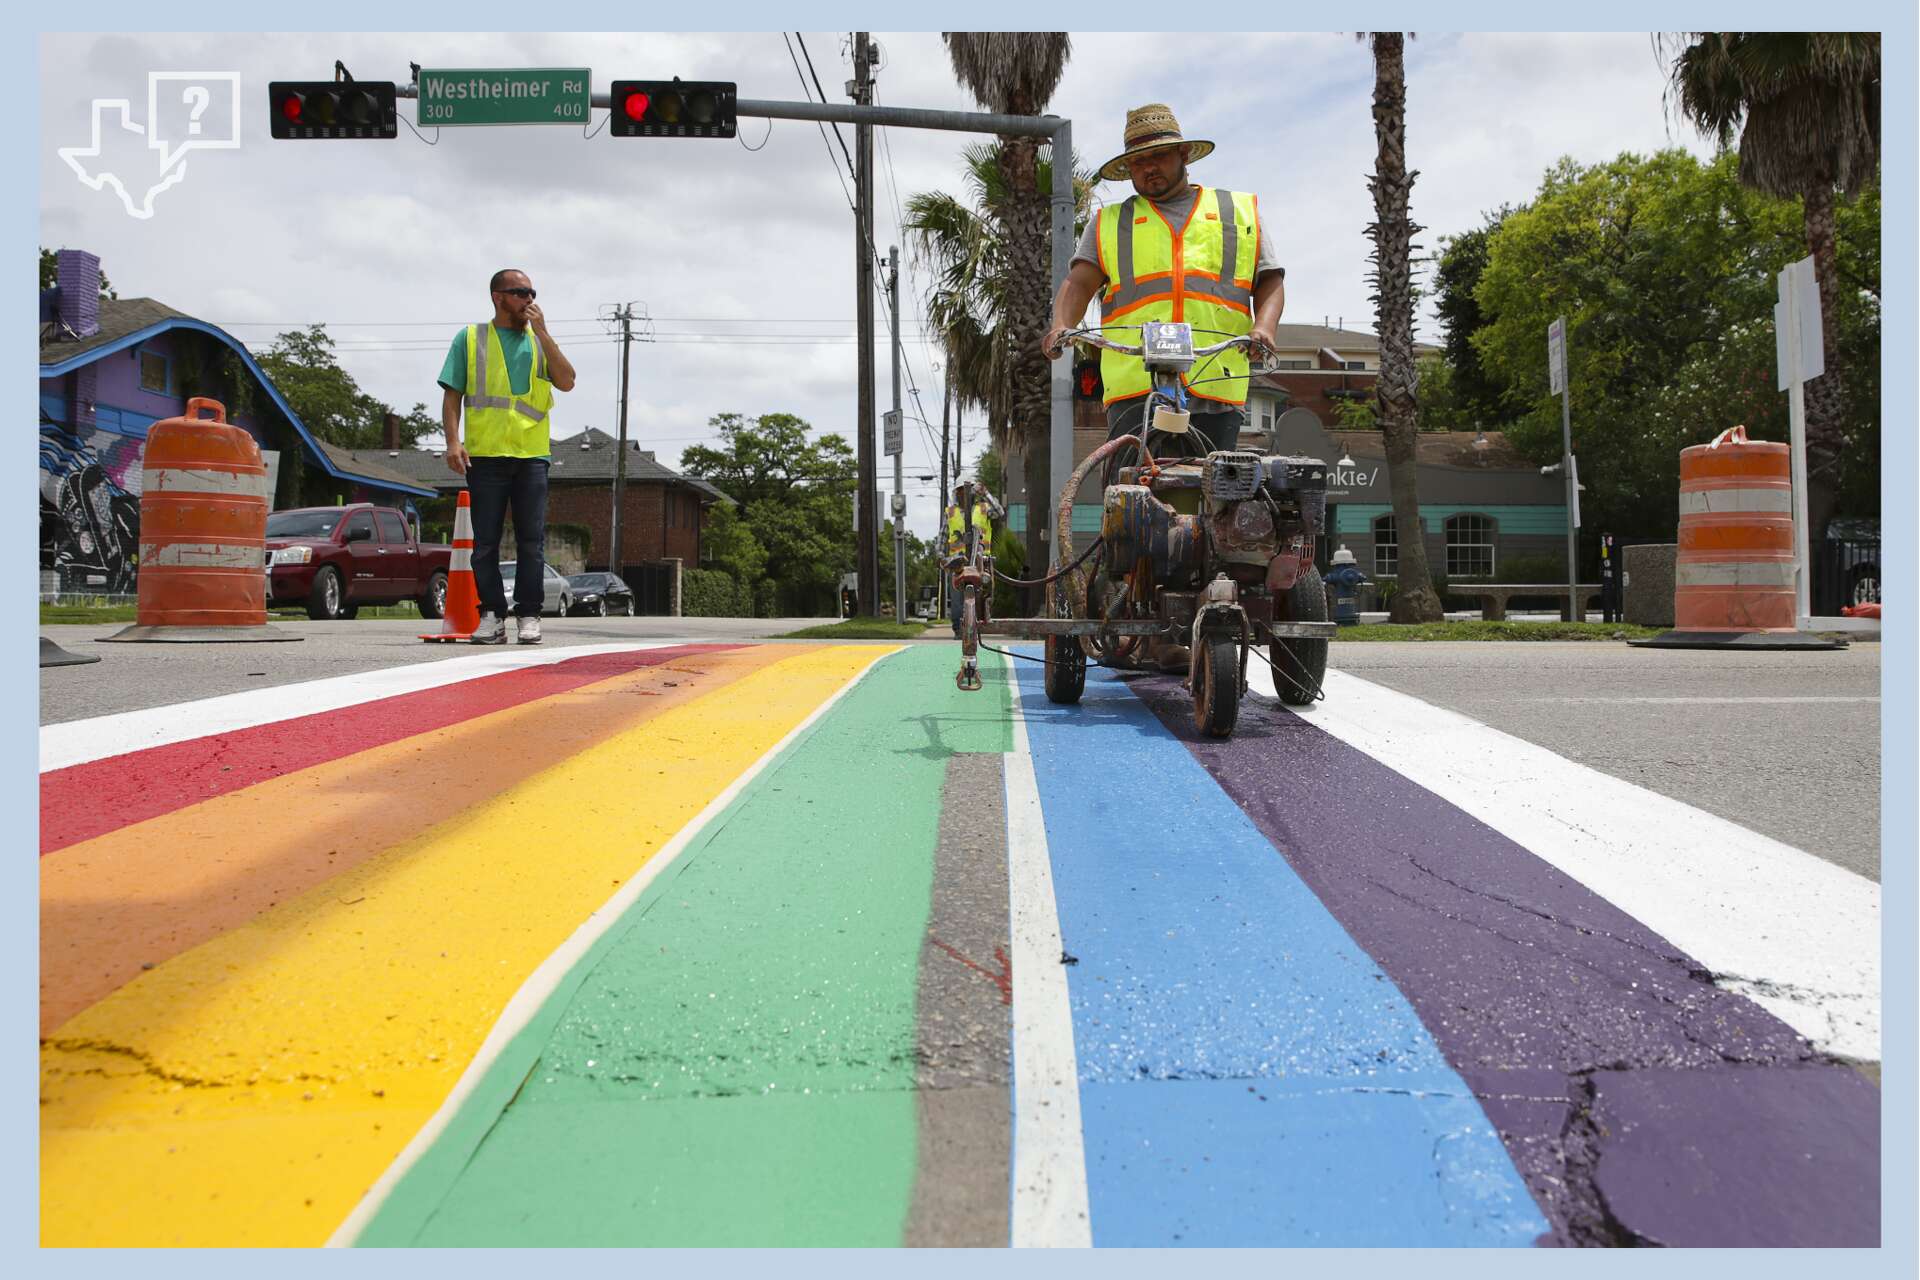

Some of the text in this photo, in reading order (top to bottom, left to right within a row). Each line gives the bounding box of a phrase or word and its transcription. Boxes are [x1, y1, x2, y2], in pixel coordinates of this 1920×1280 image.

[426, 77, 582, 99] Westheimer Rd
[426, 103, 582, 118] 300 400
